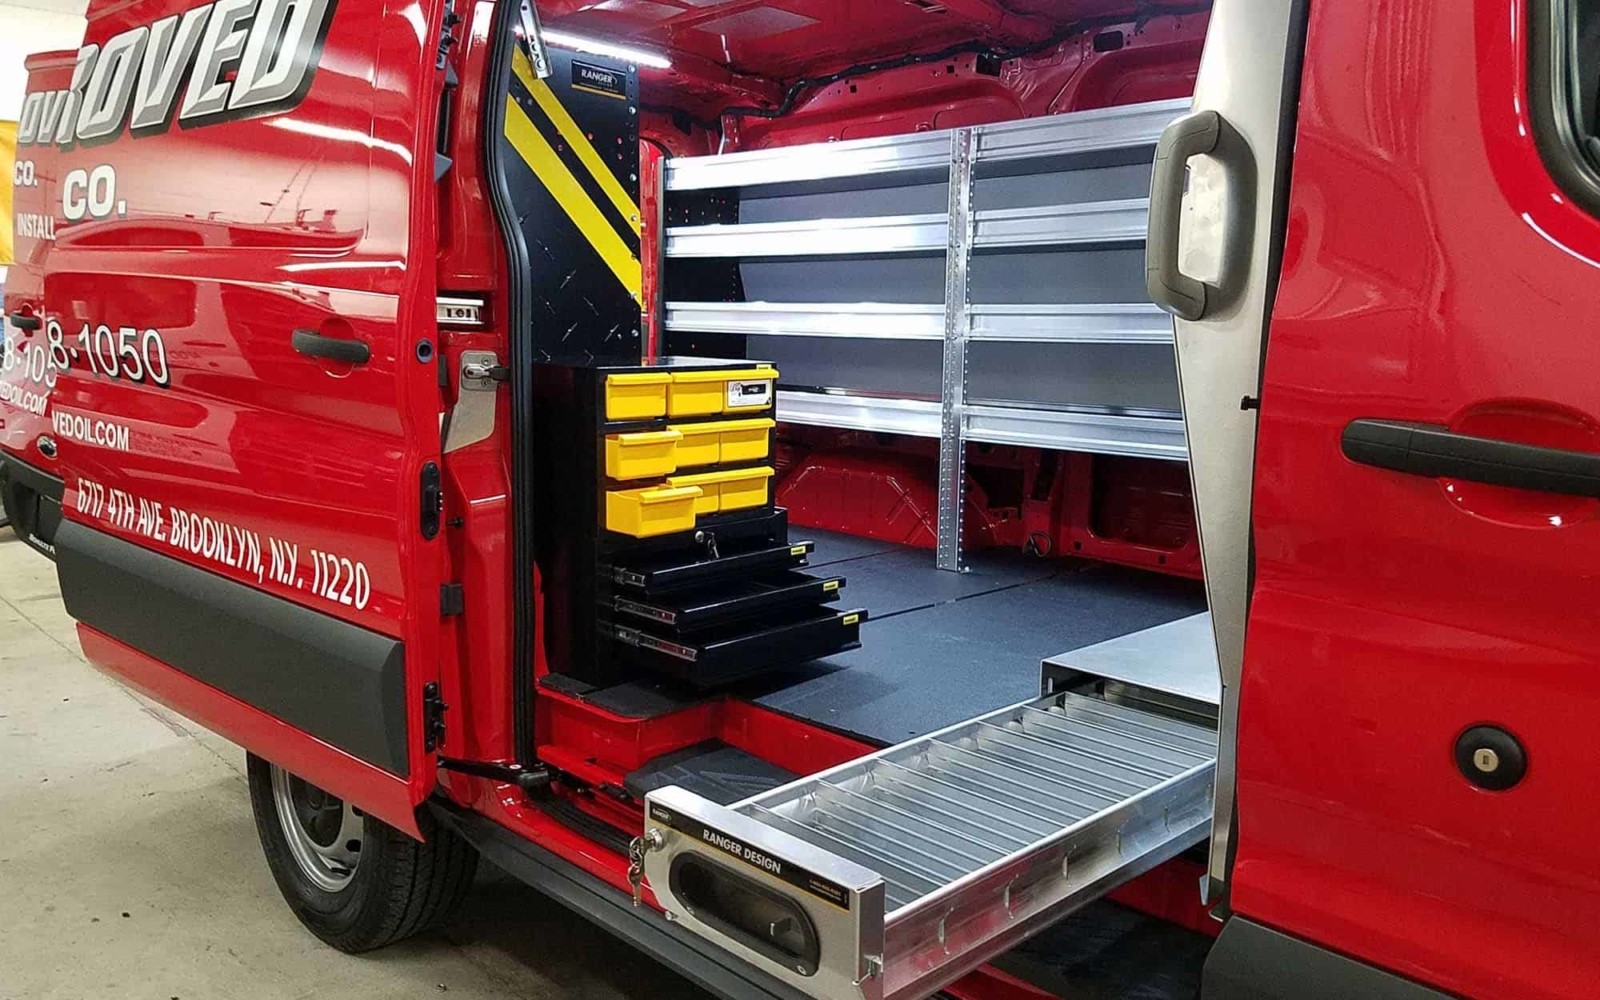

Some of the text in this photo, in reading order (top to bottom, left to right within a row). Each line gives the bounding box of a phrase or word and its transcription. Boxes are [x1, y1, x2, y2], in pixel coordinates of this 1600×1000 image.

[581, 69, 613, 83] RANGER
[14, 160, 38, 186] CO.
[63, 165, 126, 219] CO.
[77, 477, 104, 518] 6717
[107, 488, 134, 530] 4TH
[169, 507, 264, 584] BROOKLYN,
[310, 549, 370, 610] 11220
[703, 829, 781, 874] RANGER DESIGN
